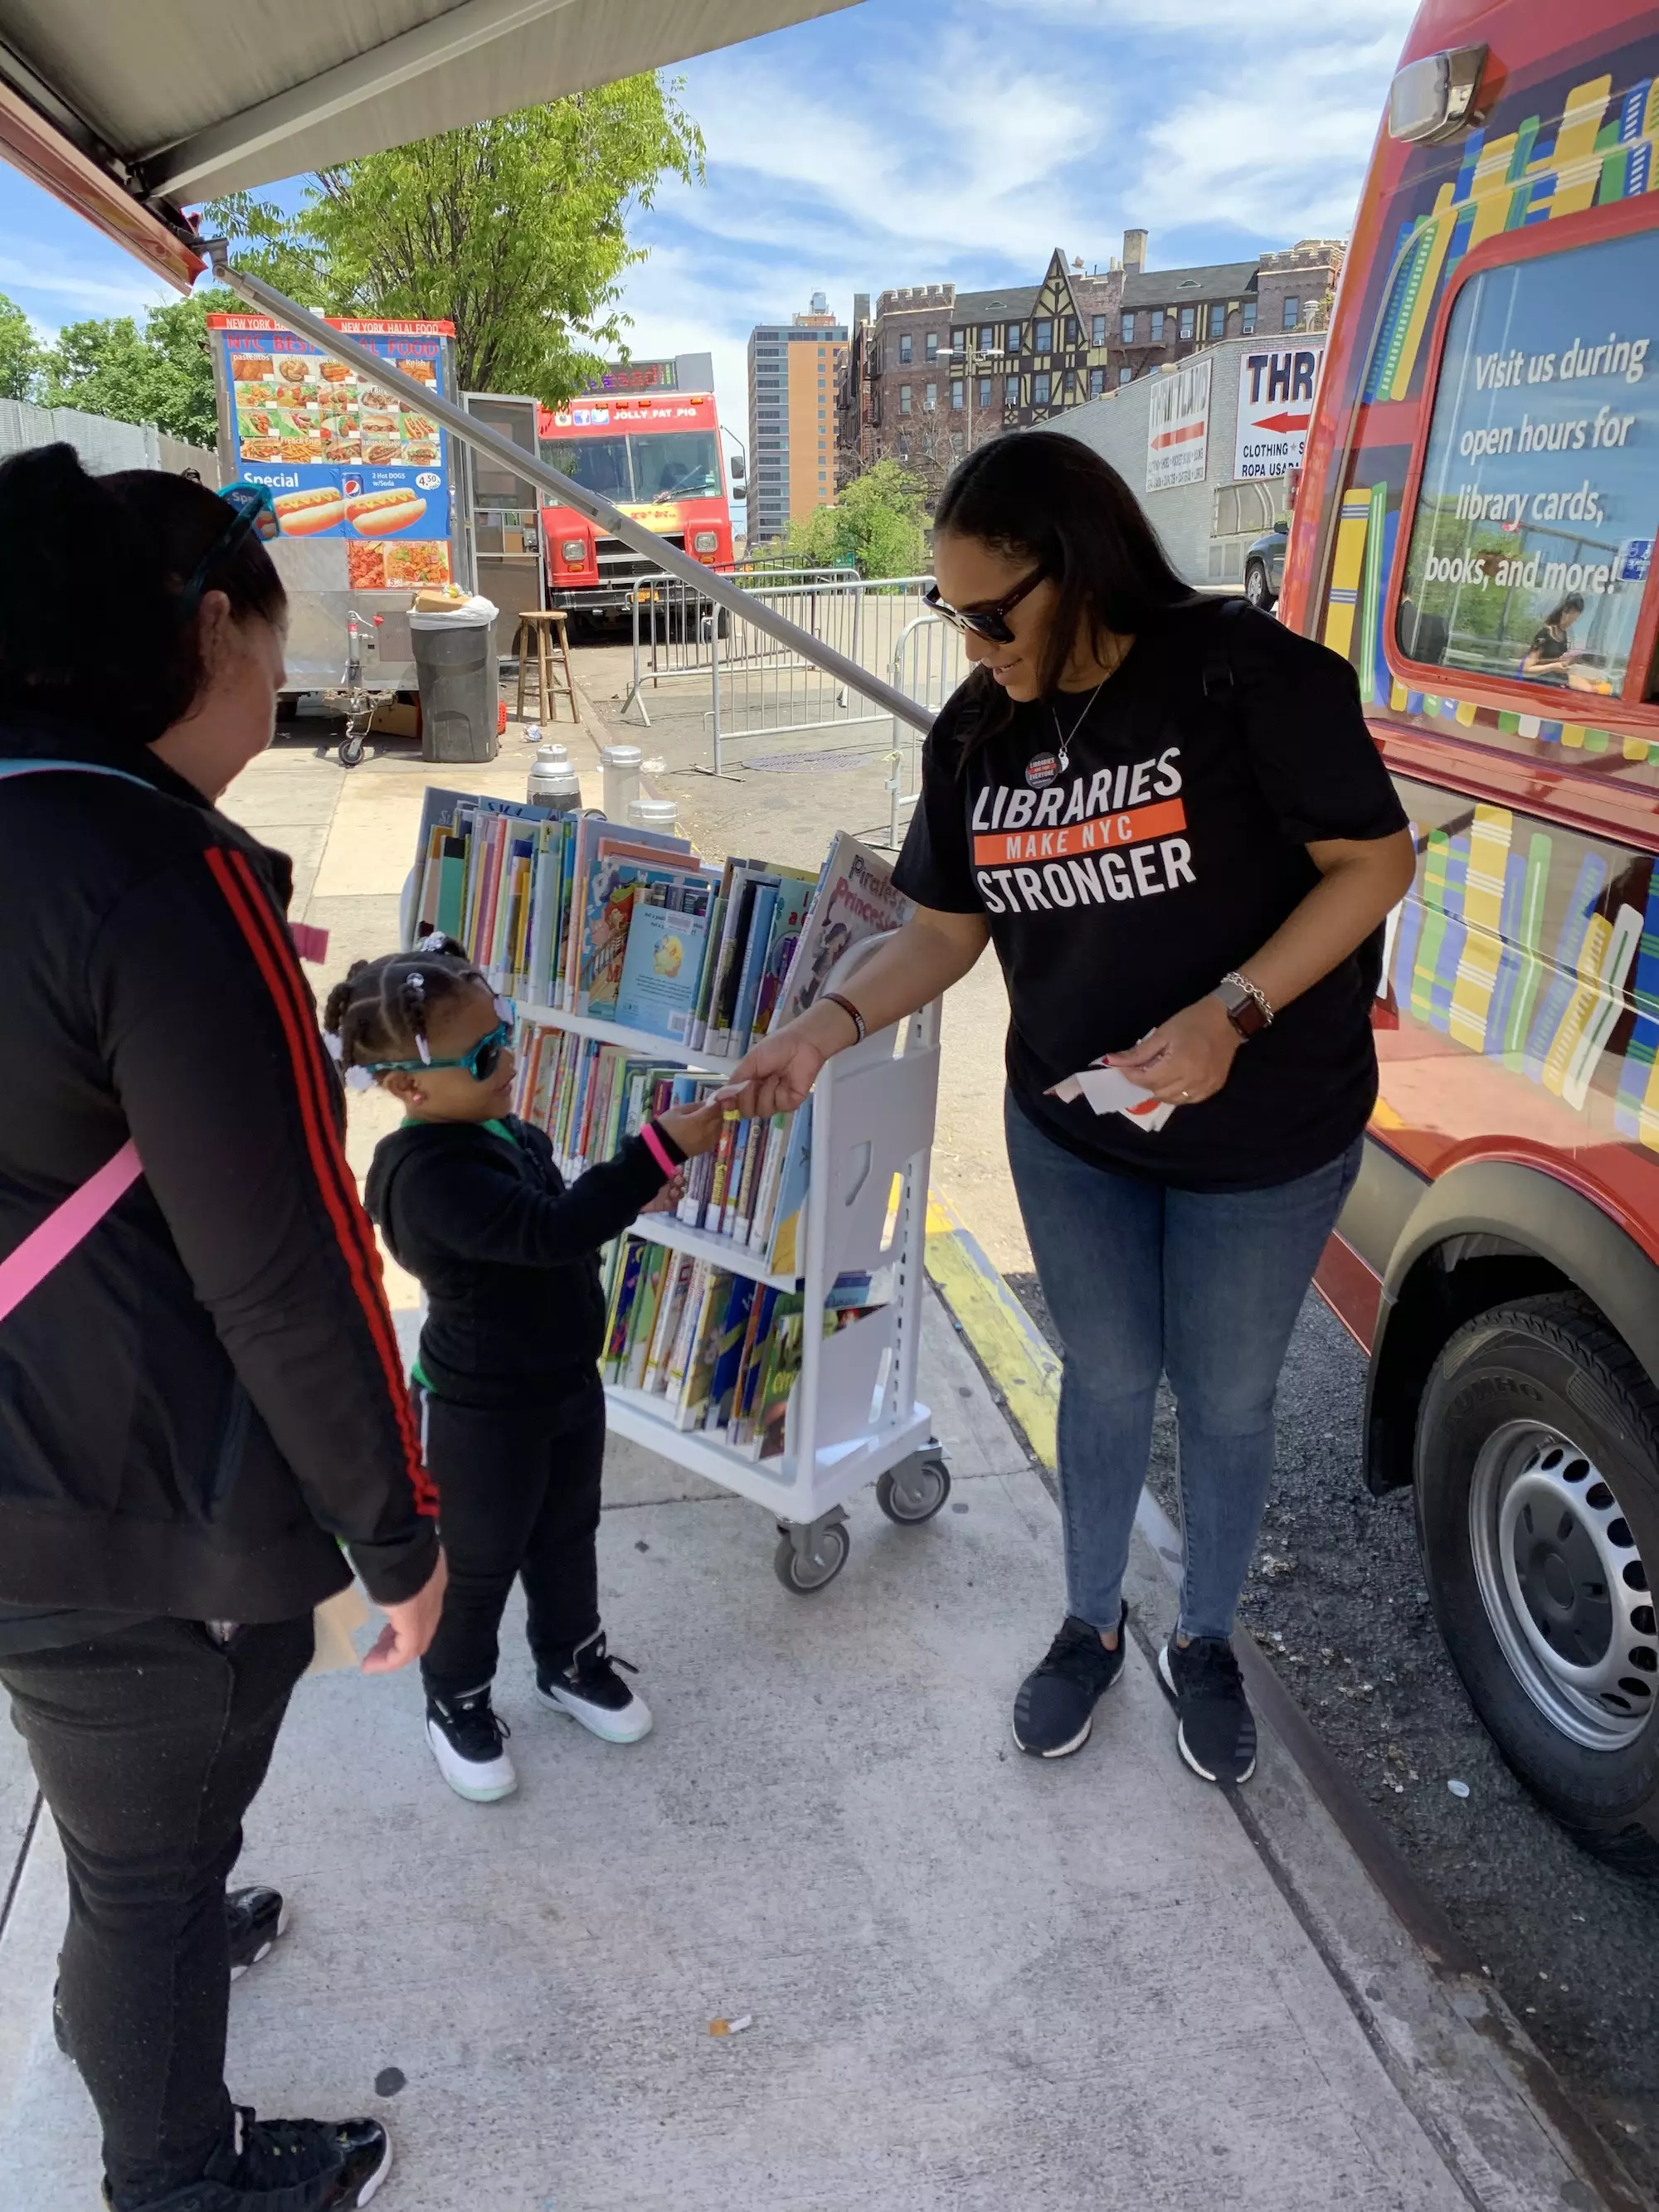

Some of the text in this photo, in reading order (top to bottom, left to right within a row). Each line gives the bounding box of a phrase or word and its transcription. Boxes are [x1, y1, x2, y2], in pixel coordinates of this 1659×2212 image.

[226, 318, 246, 329] NEW
[247, 318, 271, 330] YORK
[226, 333, 265, 352] NYC
[341, 322, 439, 334] NEW YORK HALAL FOOD
[387, 338, 439, 357] FOOD
[405, 358, 427, 367] Knish
[1475, 332, 1651, 391] Visit us during
[1246, 352, 1323, 405] THR
[1243, 442, 1288, 458] CLOTHING
[1460, 405, 1636, 466] open hours for
[243, 472, 299, 487] Special
[1242, 463, 1266, 477] ROPA
[1454, 479, 1604, 533] library cards,
[1424, 546, 1489, 591] books,
[1495, 550, 1540, 589] and
[1543, 555, 1620, 595] more!
[971, 746, 1183, 831] LIBRARIES
[1005, 814, 1133, 860] MAKE NYC
[849, 854, 898, 907] Pirates
[977, 838, 1197, 914] STRONGER
